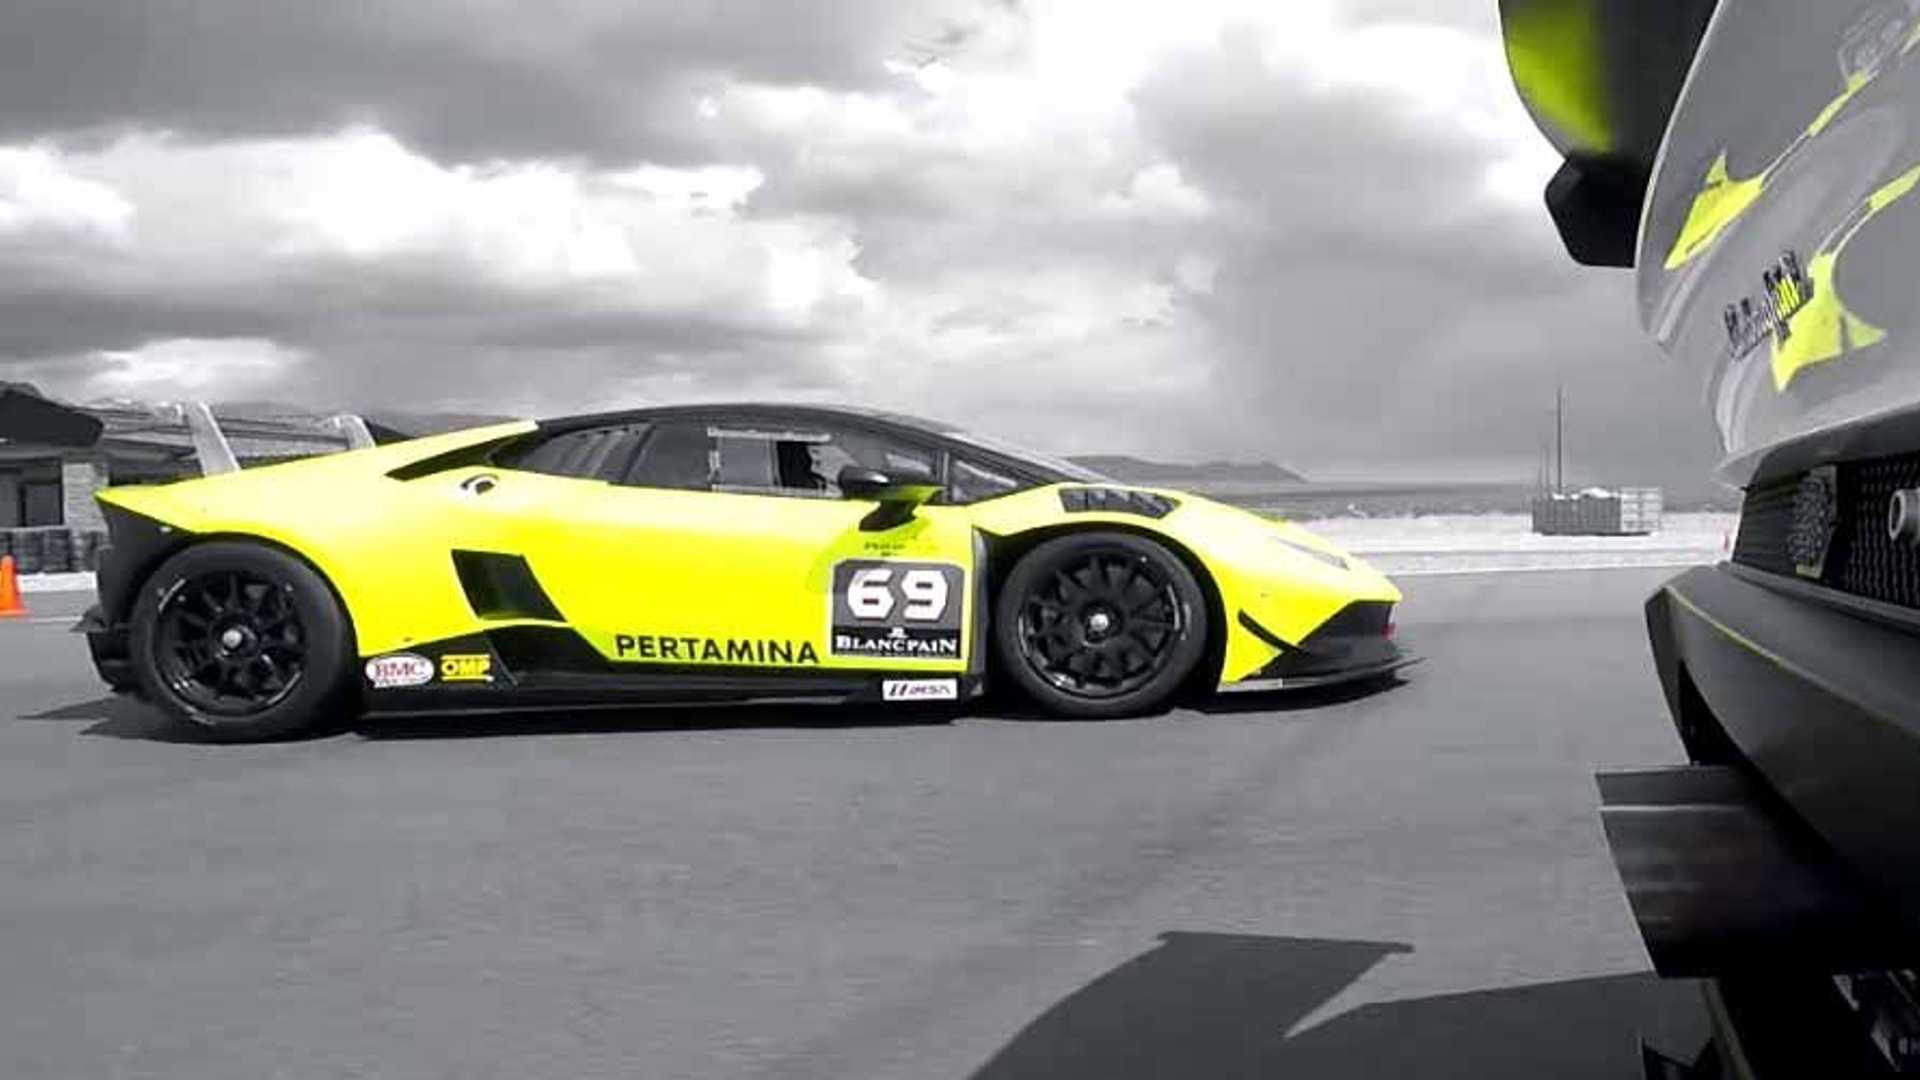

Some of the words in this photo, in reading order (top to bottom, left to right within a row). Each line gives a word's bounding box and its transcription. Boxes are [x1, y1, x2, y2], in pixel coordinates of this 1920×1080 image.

[848, 568, 948, 621] 69
[616, 634, 819, 664] PERTAMINA
[836, 635, 956, 652] BLANCPAIN
[441, 660, 490, 676] OMP
